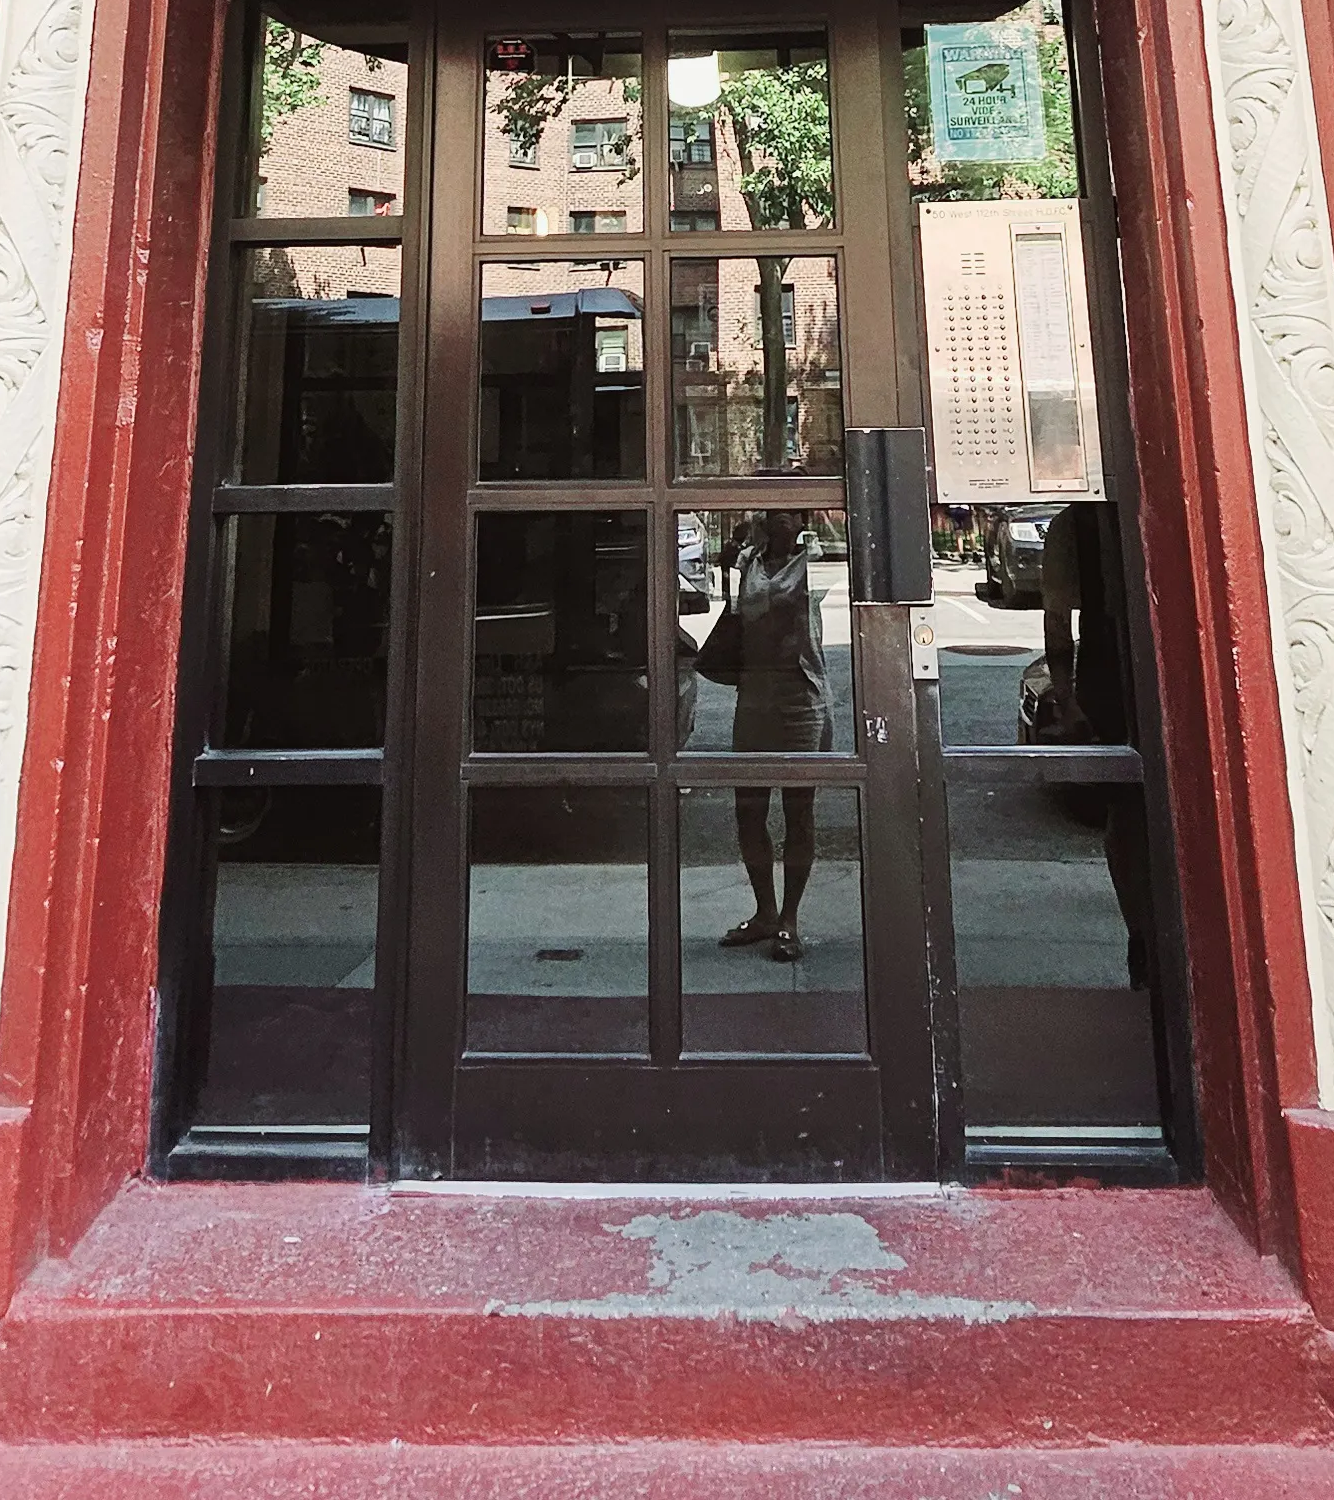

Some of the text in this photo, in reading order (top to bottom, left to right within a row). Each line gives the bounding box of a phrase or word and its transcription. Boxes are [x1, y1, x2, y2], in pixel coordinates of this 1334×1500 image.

[963, 96, 1007, 106] 24 HOUR
[971, 106, 1002, 115] VIDE
[932, 208, 946, 219] 50
